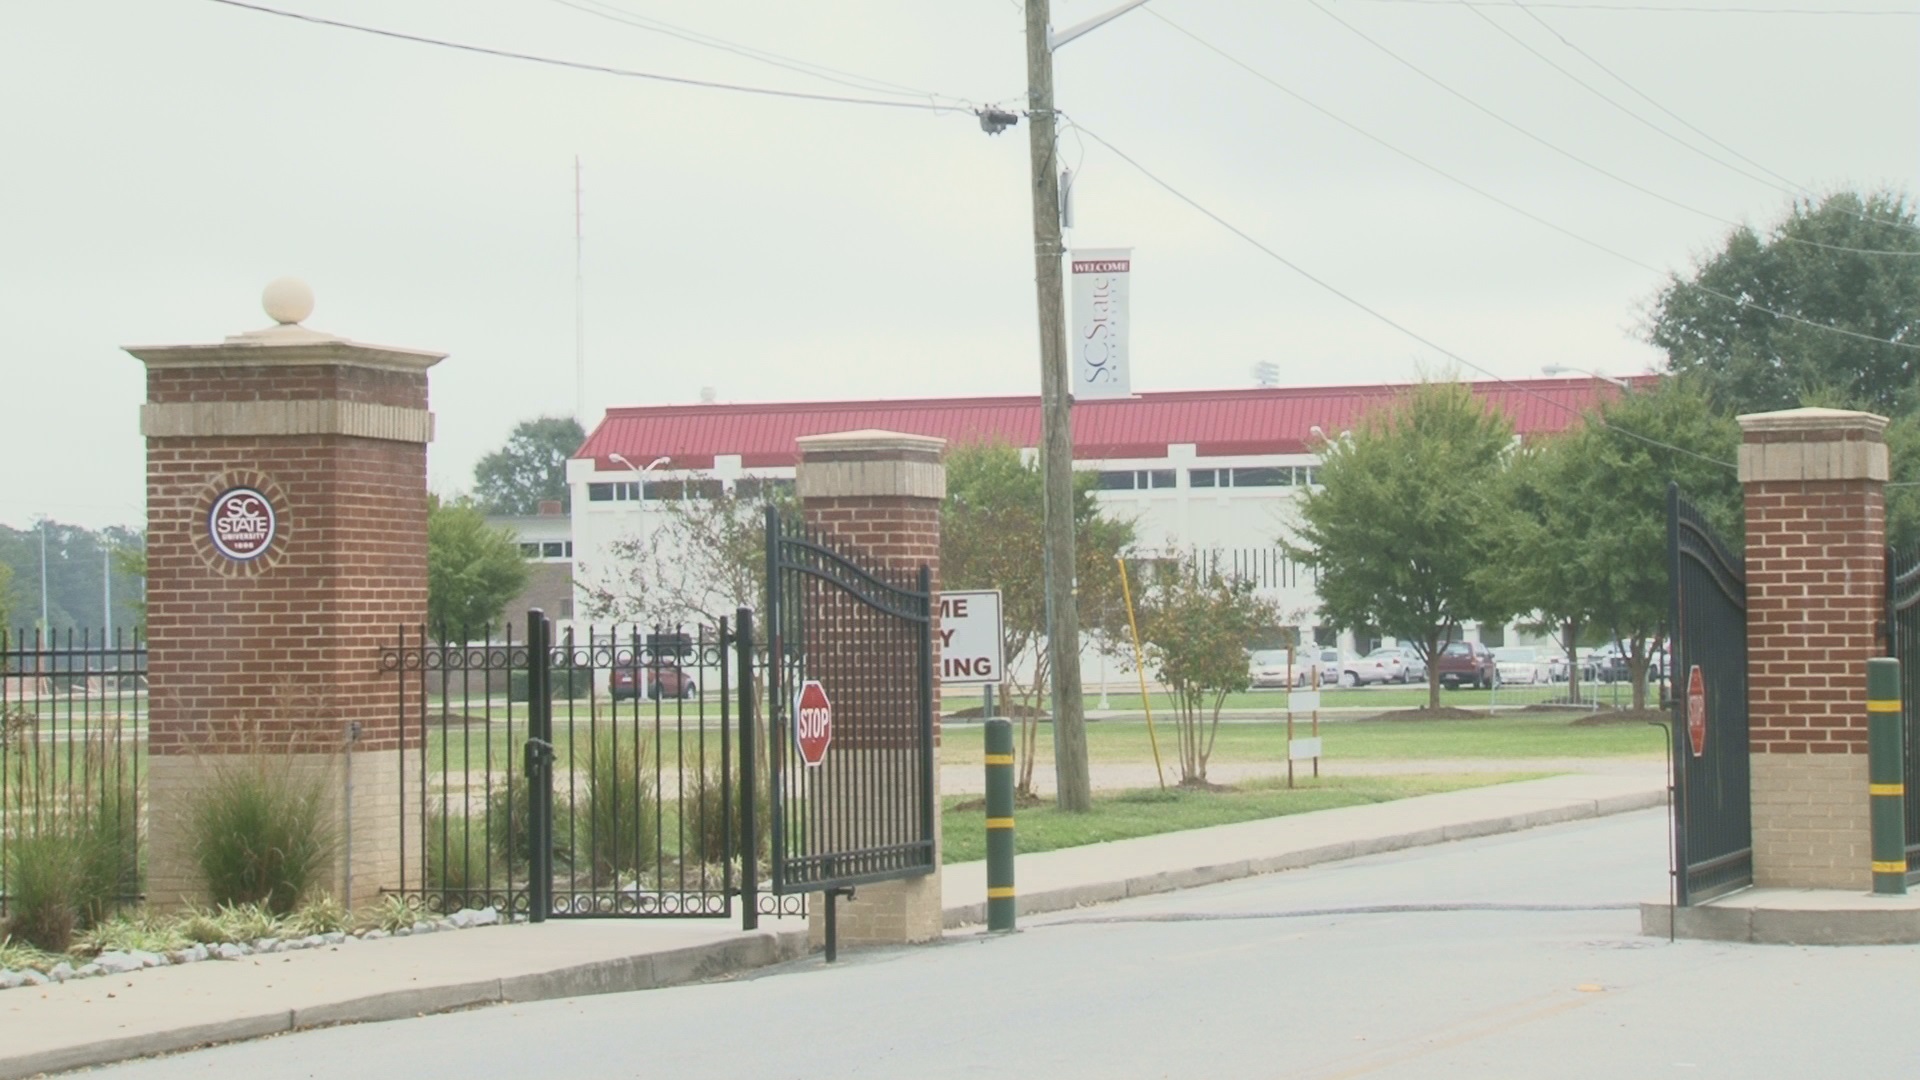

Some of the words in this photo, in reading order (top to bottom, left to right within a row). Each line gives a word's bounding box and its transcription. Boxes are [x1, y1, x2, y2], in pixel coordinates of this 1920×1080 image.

[1074, 262, 1129, 272] WELCOME
[226, 498, 260, 518] SC
[218, 516, 268, 533] STATE
[221, 532, 266, 541] UNIVERSITY
[940, 657, 991, 677] ING
[800, 707, 829, 739] STOP
